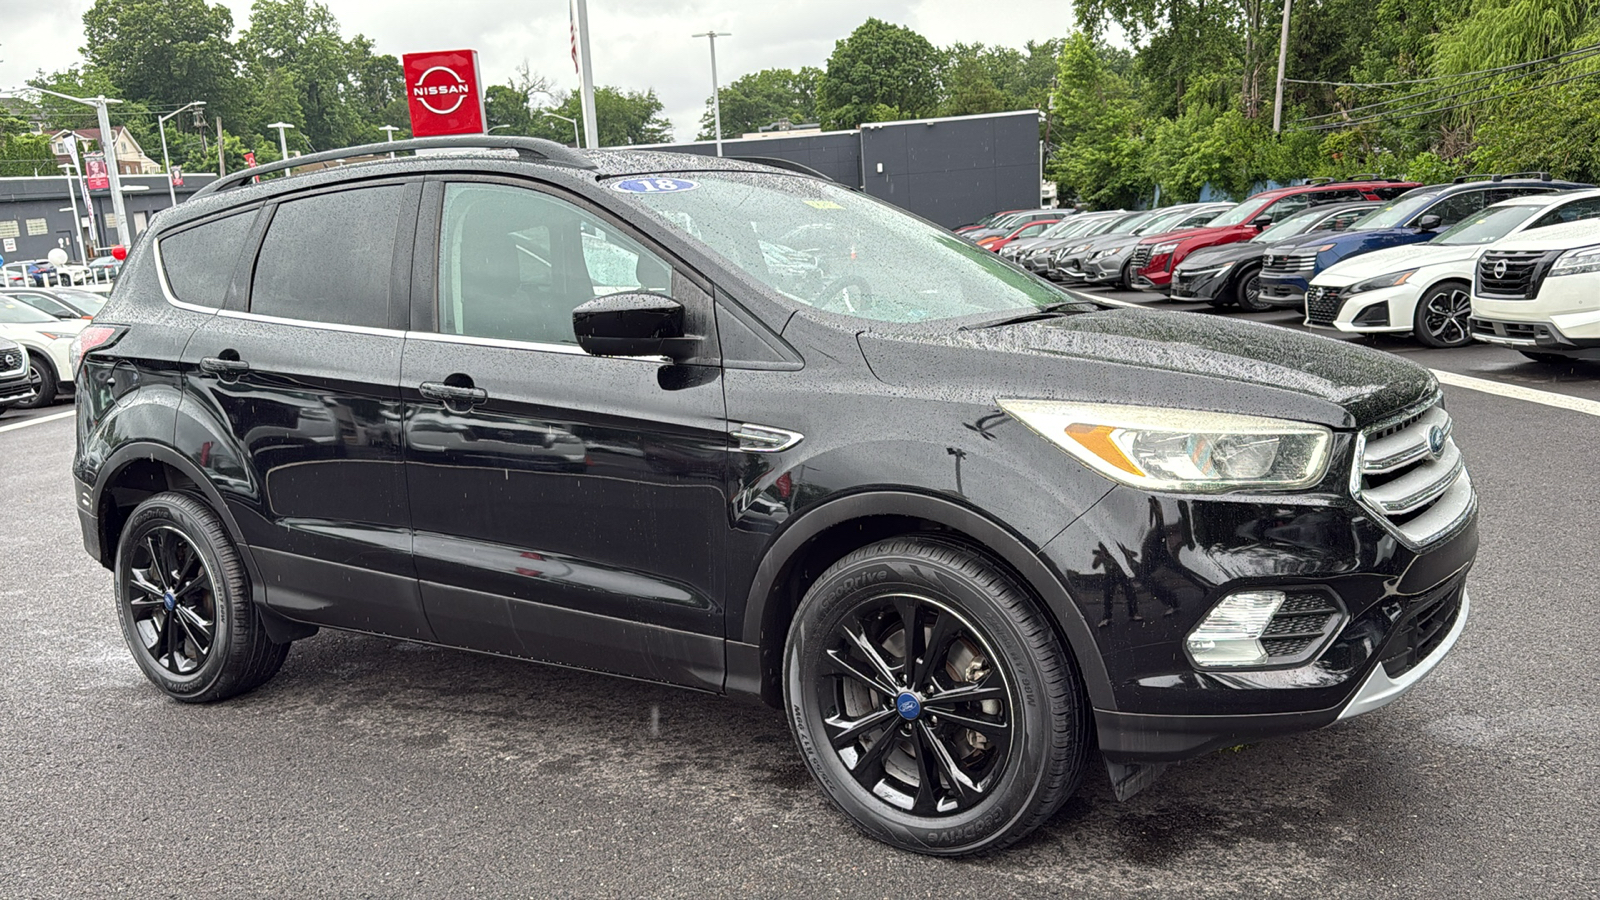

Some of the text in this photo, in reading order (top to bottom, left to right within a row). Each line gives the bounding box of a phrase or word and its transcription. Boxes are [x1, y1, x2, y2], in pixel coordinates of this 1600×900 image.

[413, 84, 469, 96] NISSAN
[637, 179, 678, 192] 18
[821, 570, 888, 609] GeoDrive
[1010, 651, 1027, 675] R17
[1021, 678, 1036, 708] 99W
[793, 704, 805, 730] 99W
[800, 733, 814, 755] R17
